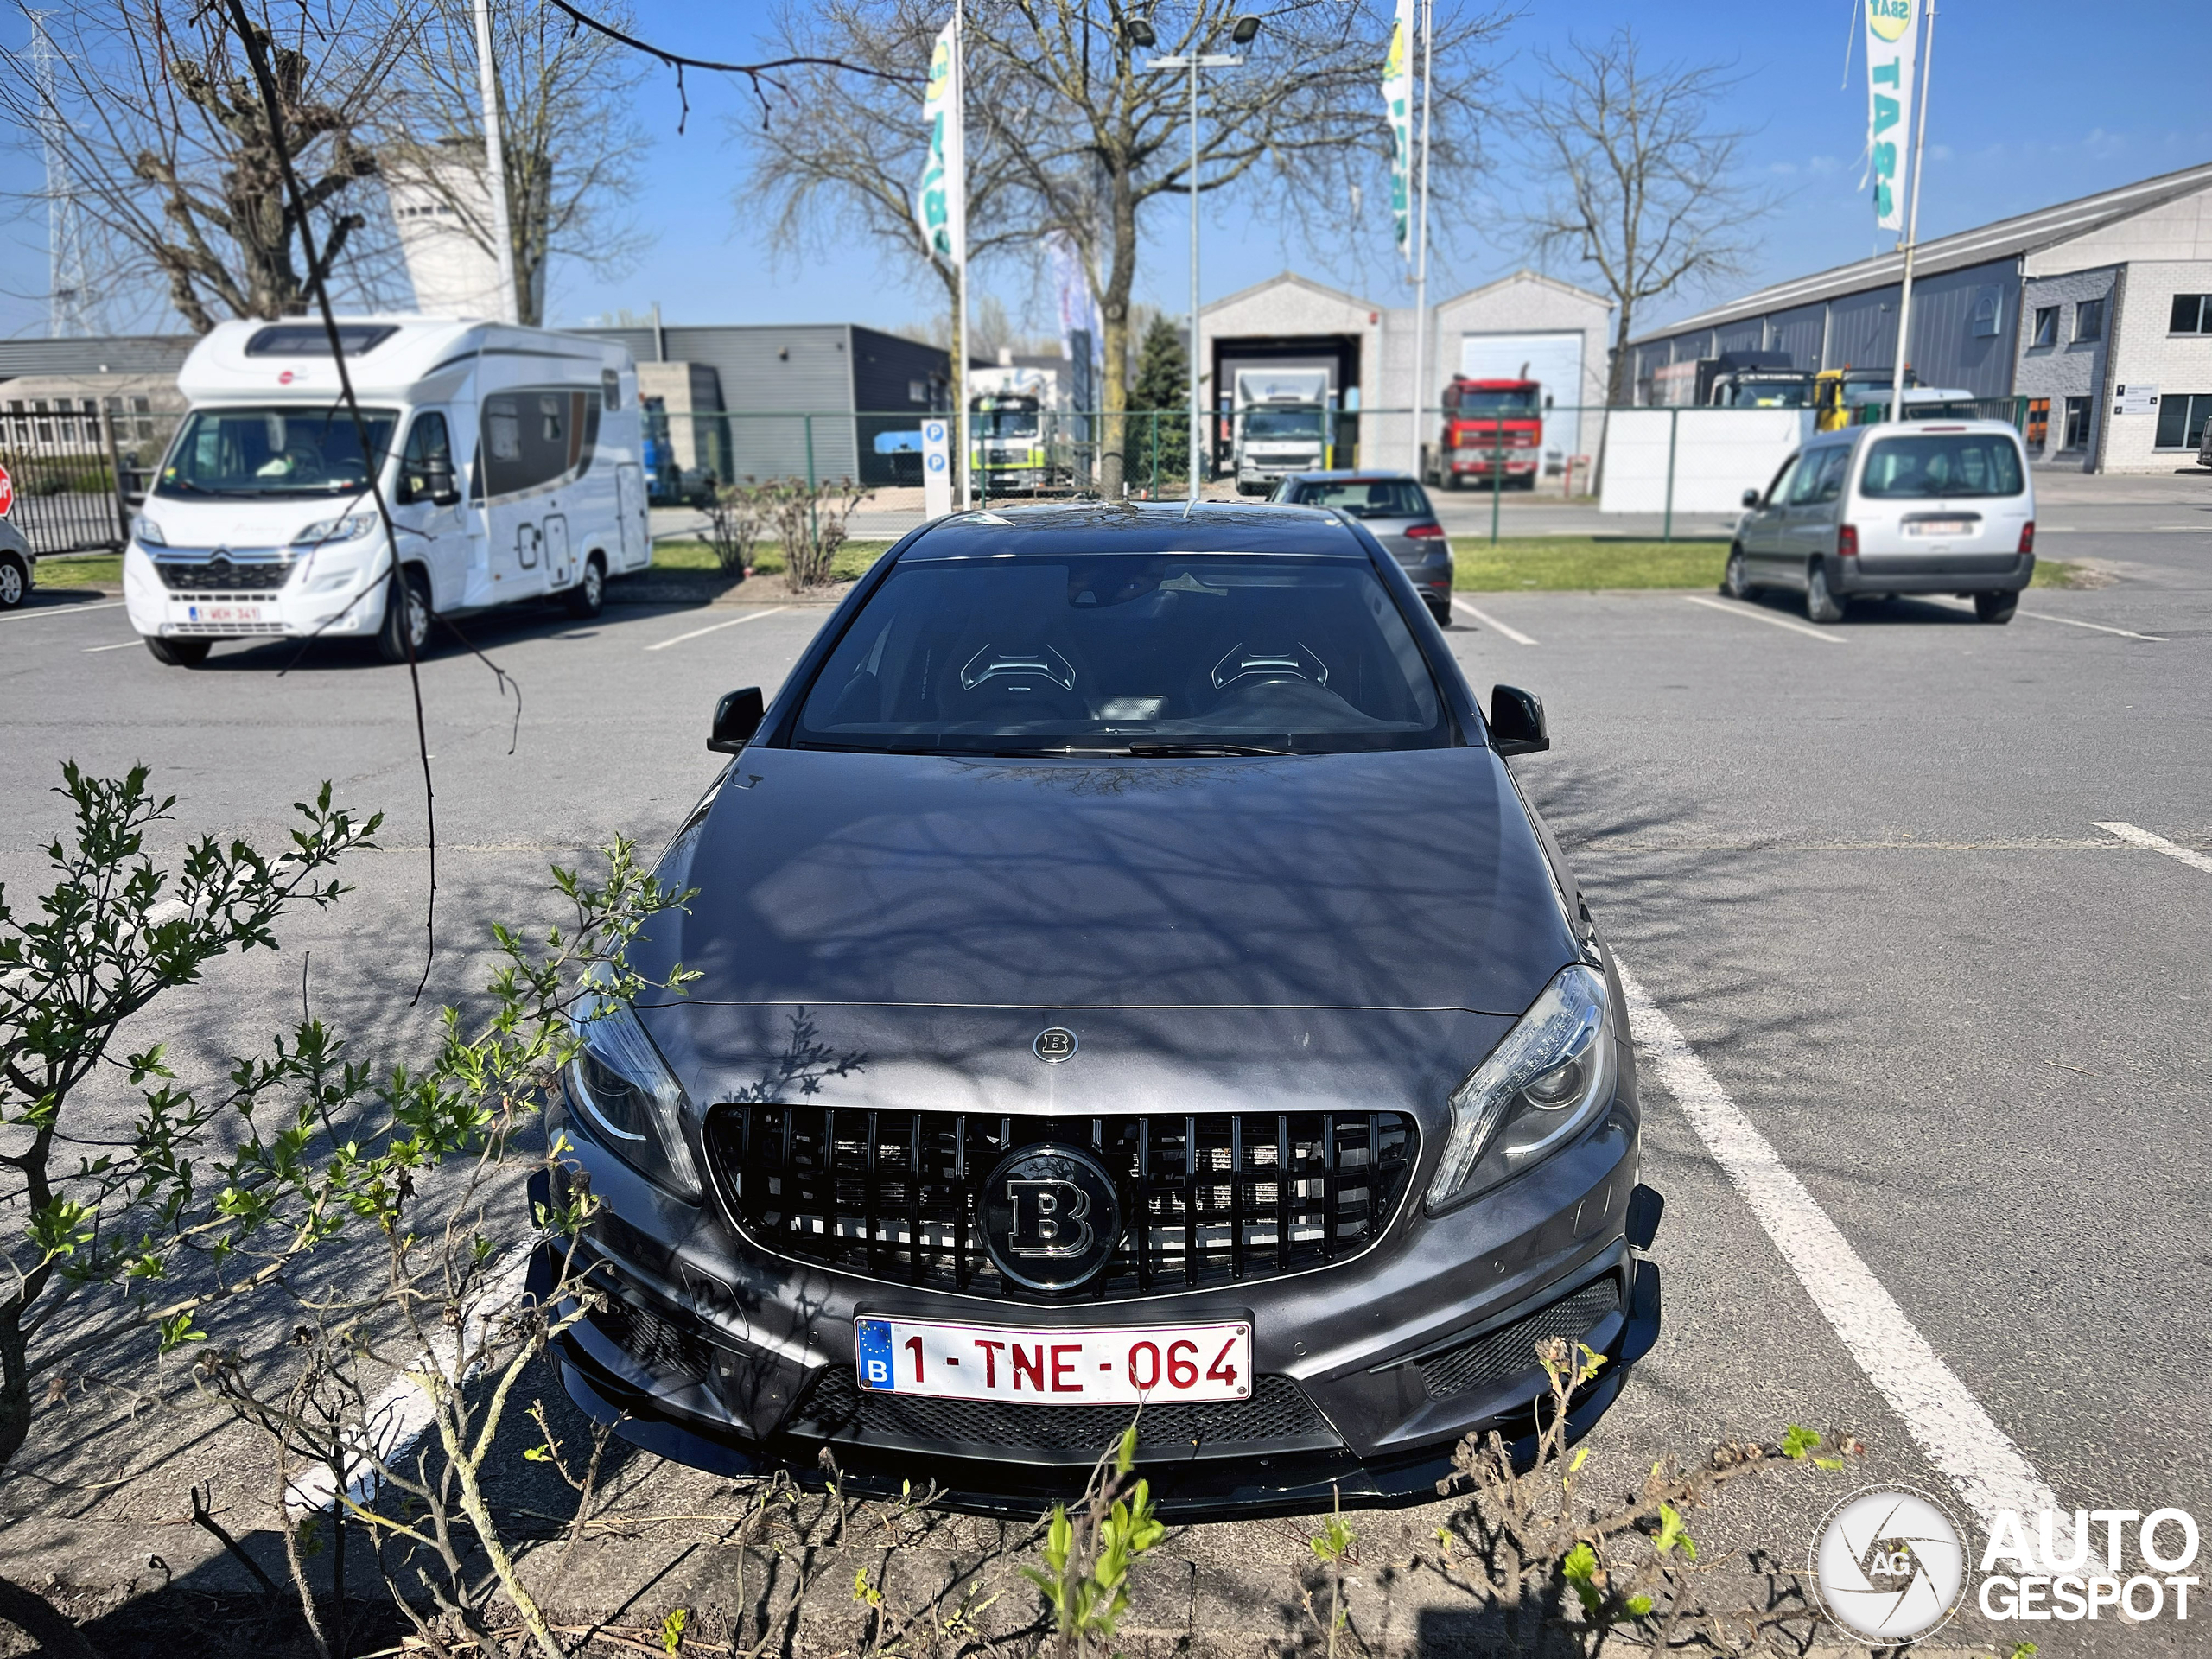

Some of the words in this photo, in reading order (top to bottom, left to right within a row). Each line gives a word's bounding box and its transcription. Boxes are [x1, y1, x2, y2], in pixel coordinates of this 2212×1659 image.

[1042, 1033, 1069, 1053] B
[1007, 1180, 1094, 1259] B
[868, 1359, 888, 1382] B
